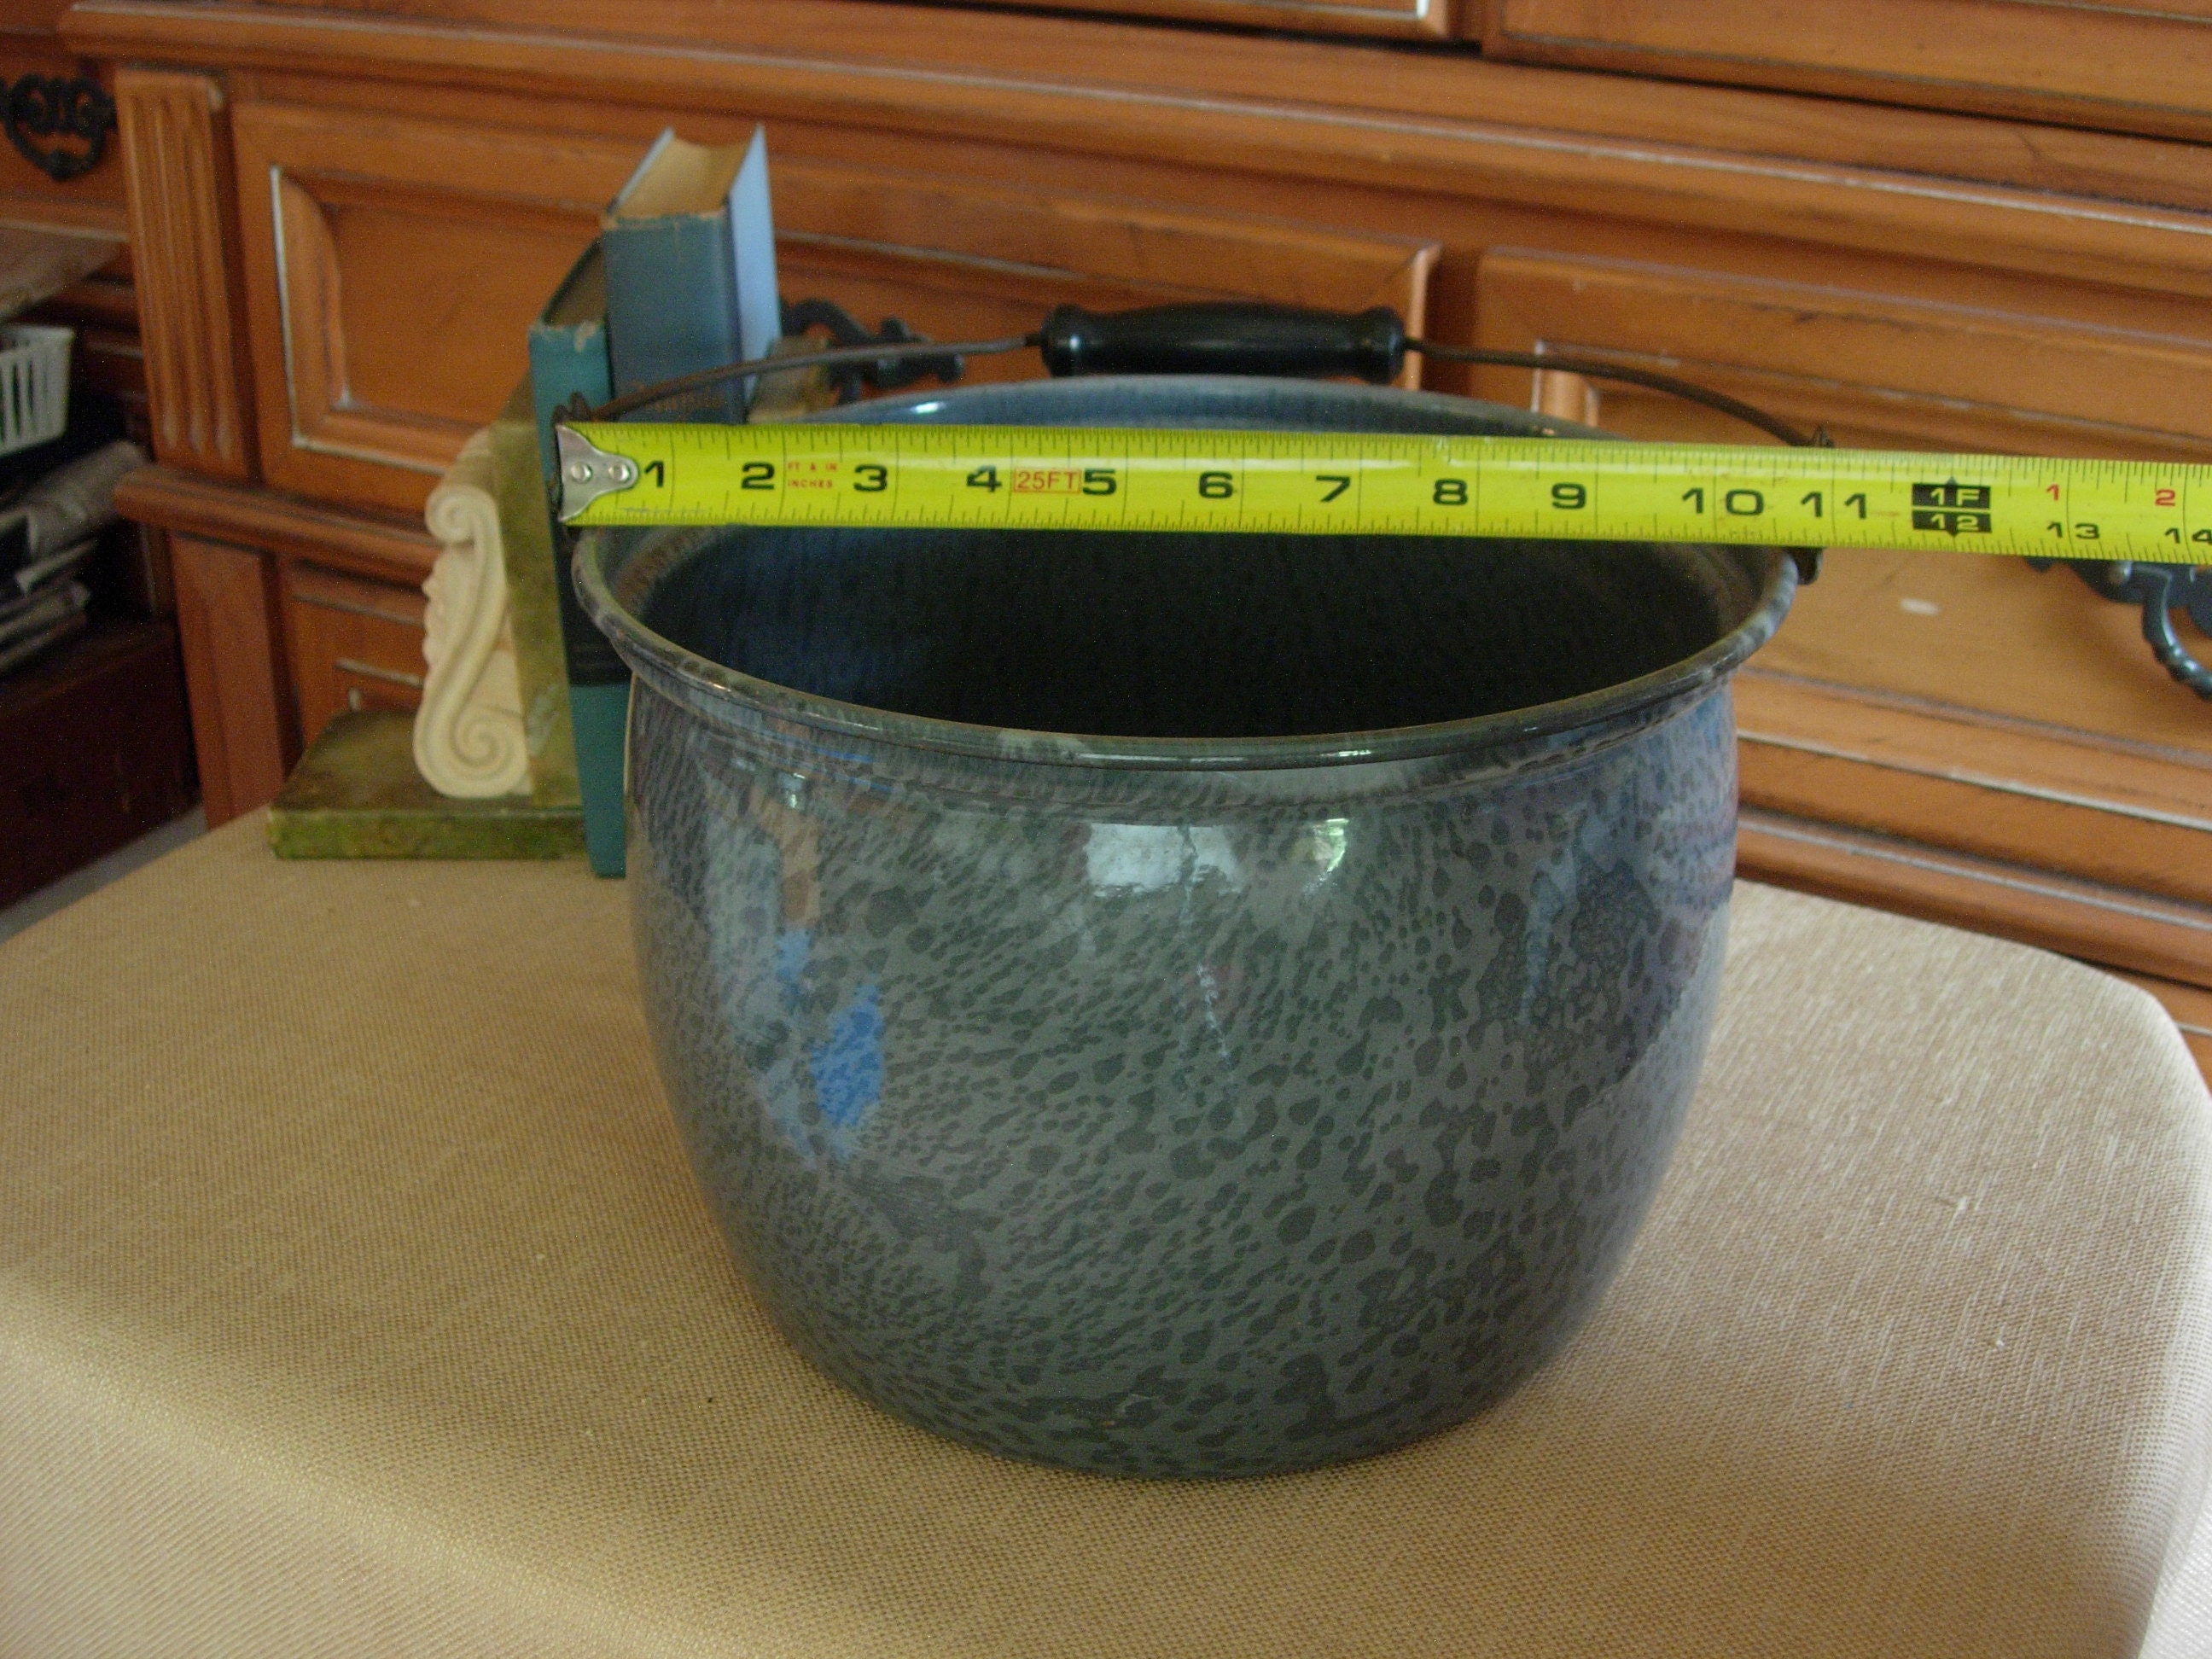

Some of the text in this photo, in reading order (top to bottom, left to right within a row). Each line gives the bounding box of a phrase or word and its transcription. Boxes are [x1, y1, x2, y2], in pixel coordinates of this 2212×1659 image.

[643, 460, 664, 487] 1
[741, 462, 776, 490] 2
[787, 479, 833, 489] INCHES
[853, 463, 888, 492] 3
[966, 464, 1002, 493] 4
[1017, 469, 1079, 492] 25FT
[1082, 468, 1117, 495] 5
[1198, 471, 1233, 498] 6
[1315, 474, 1352, 503] 7
[1433, 478, 1469, 506] 8
[1551, 482, 1587, 509] 9
[1681, 487, 1765, 515] 10
[2046, 484, 2060, 501] 1
[2155, 488, 2176, 507] 2
[1801, 491, 1867, 520] 11
[1930, 514, 1980, 532] 12
[2046, 521, 2100, 539] 13
